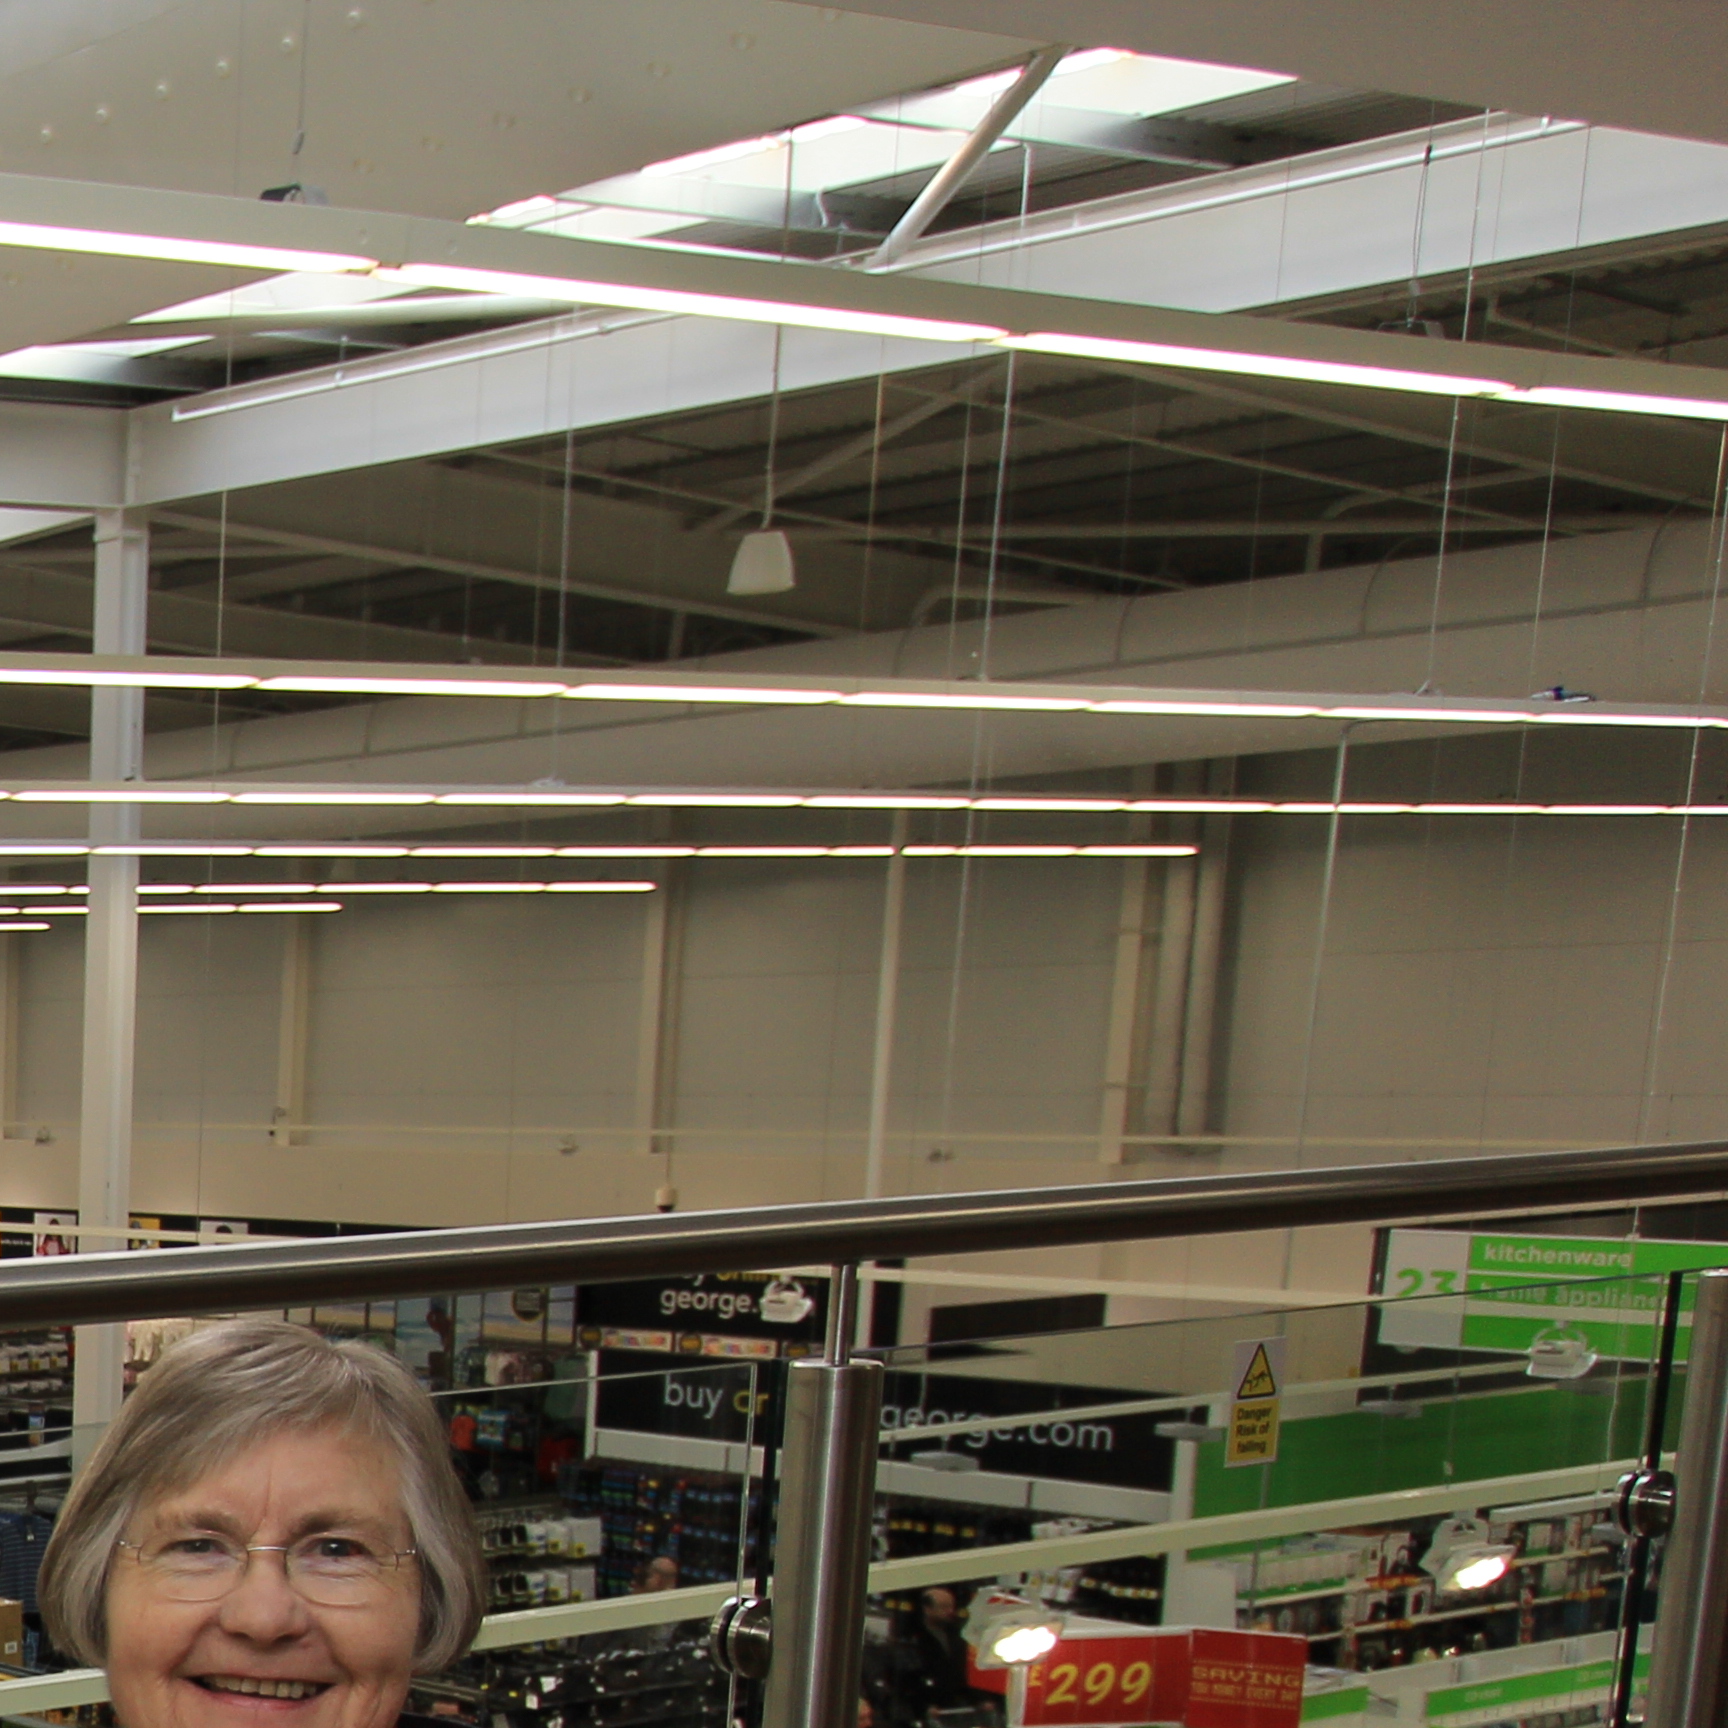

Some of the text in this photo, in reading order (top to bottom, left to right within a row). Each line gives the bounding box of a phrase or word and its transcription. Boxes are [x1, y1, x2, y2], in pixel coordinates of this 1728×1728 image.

[1484, 1243, 1635, 1267] kitchenware
[660, 1288, 758, 1320] george.
[664, 1372, 724, 1420] buy
[1192, 1666, 1301, 1688] SAVING
